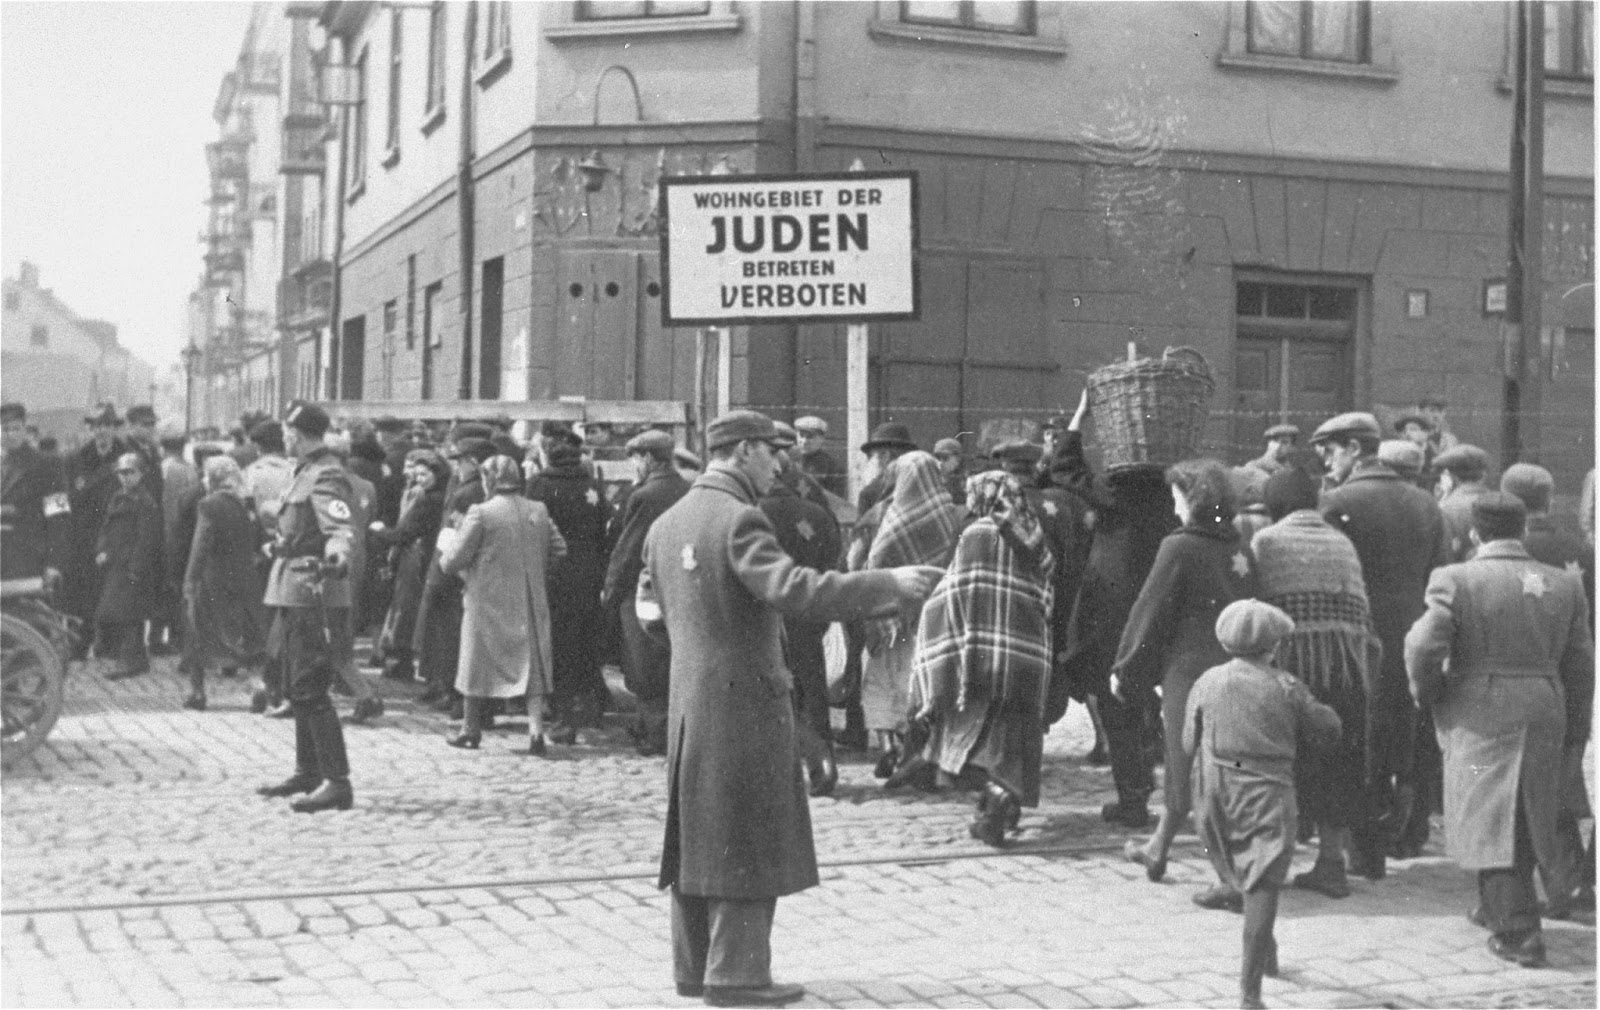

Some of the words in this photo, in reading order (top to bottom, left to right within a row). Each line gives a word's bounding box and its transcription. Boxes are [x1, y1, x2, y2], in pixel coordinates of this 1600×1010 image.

[694, 190, 824, 208] WOHNGEBIET
[838, 188, 882, 206] DER
[706, 213, 869, 254] JUDEN
[743, 260, 835, 277] BETRETEN
[721, 283, 866, 308] VERBOTEN
